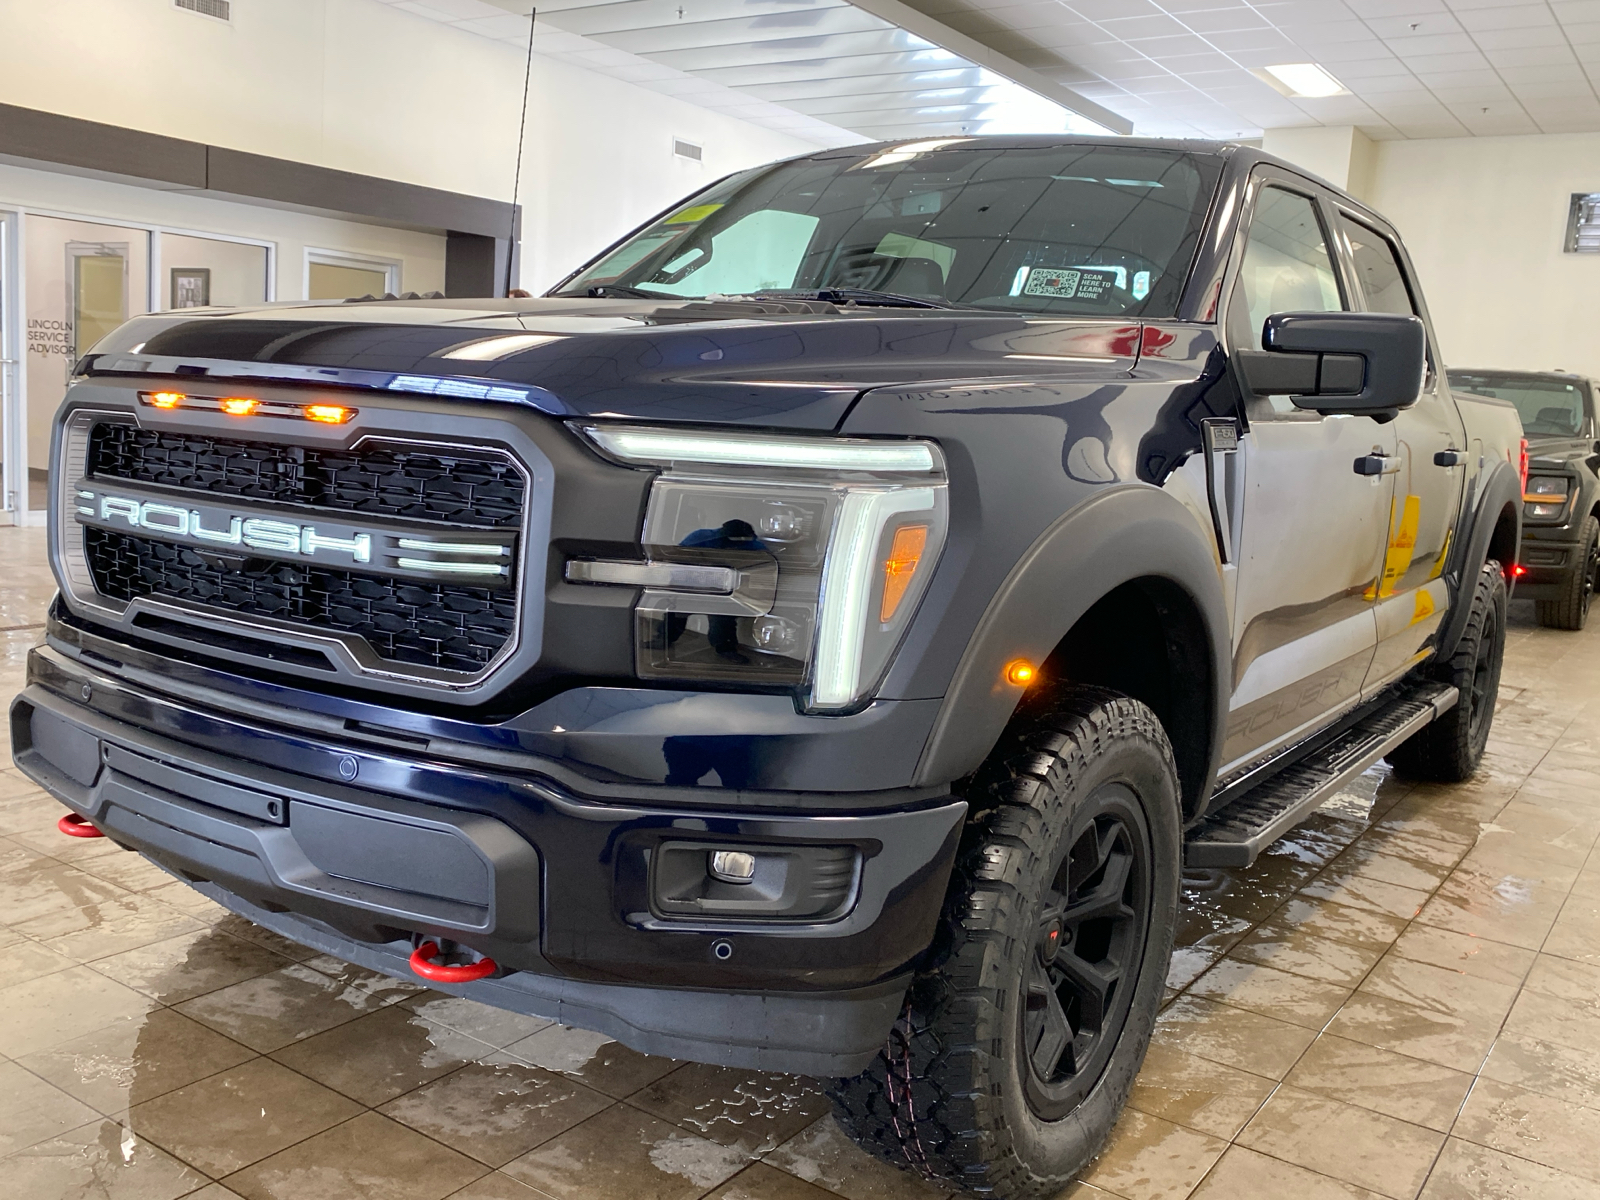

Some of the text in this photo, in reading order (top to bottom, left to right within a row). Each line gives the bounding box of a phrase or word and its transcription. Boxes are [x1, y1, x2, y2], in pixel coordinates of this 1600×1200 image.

[1081, 279, 1100, 287] HERE
[1083, 273, 1103, 281] SCAN
[1077, 291, 1098, 299] MORE
[1079, 285, 1103, 293] LEARN
[27, 318, 73, 331] LINCOLN
[28, 330, 70, 343] SERVICE
[28, 343, 76, 355] ADVISOR
[100, 497, 371, 563] ROUSH
[1226, 672, 1342, 740] ROUSH
